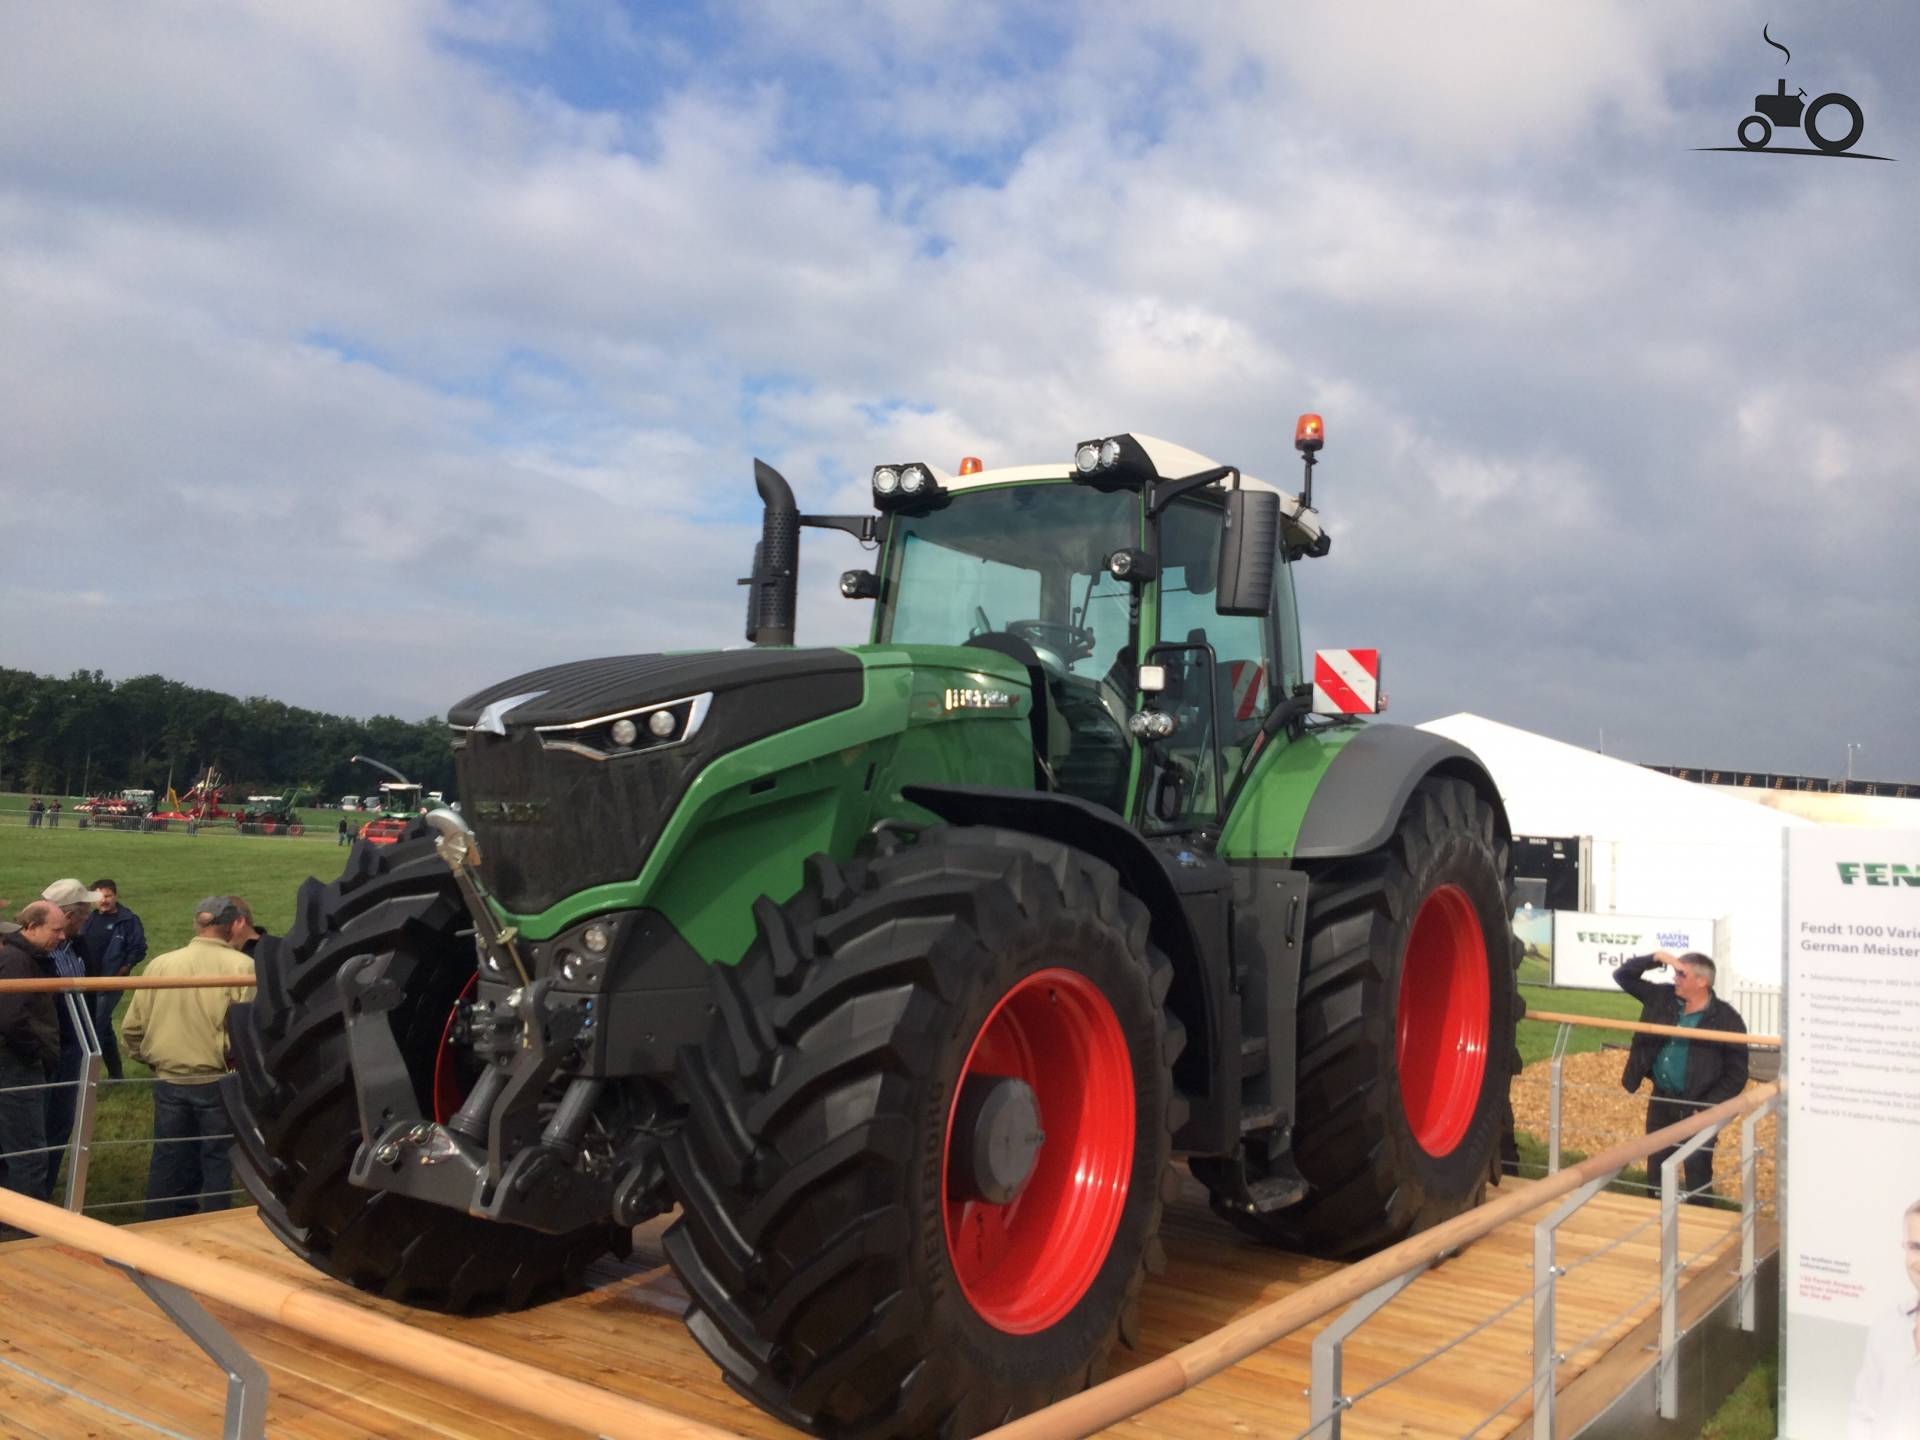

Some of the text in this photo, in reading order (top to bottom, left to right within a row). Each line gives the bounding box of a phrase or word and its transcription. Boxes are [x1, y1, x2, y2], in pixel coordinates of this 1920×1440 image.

[1800, 921, 1843, 935] Fendt
[1848, 924, 1884, 937] 1000
[1576, 930, 1643, 945] FENDT
[1655, 932, 1690, 941] SAATEN
[1800, 939, 1859, 953] German
